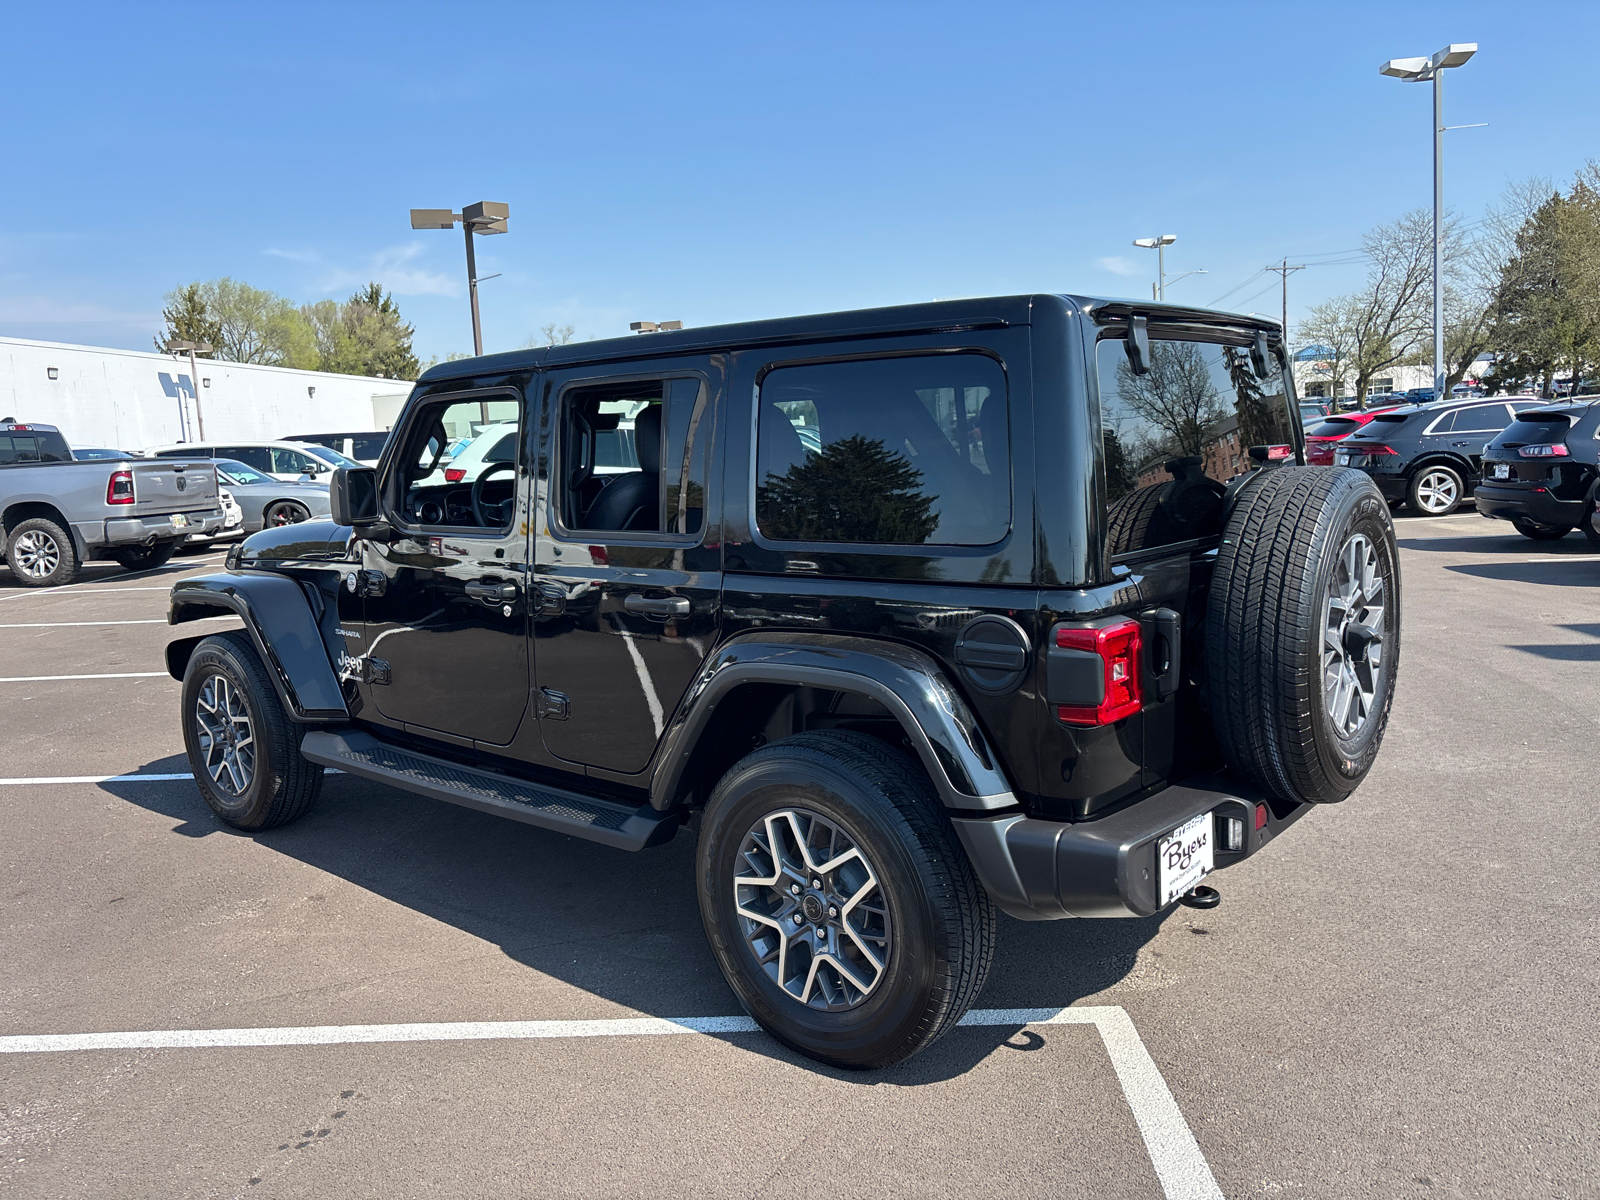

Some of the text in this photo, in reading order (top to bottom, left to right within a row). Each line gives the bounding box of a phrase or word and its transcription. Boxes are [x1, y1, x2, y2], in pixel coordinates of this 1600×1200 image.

[335, 628, 361, 639] SAHARA
[337, 650, 363, 674] Jeep
[1163, 833, 1207, 870] Byers
